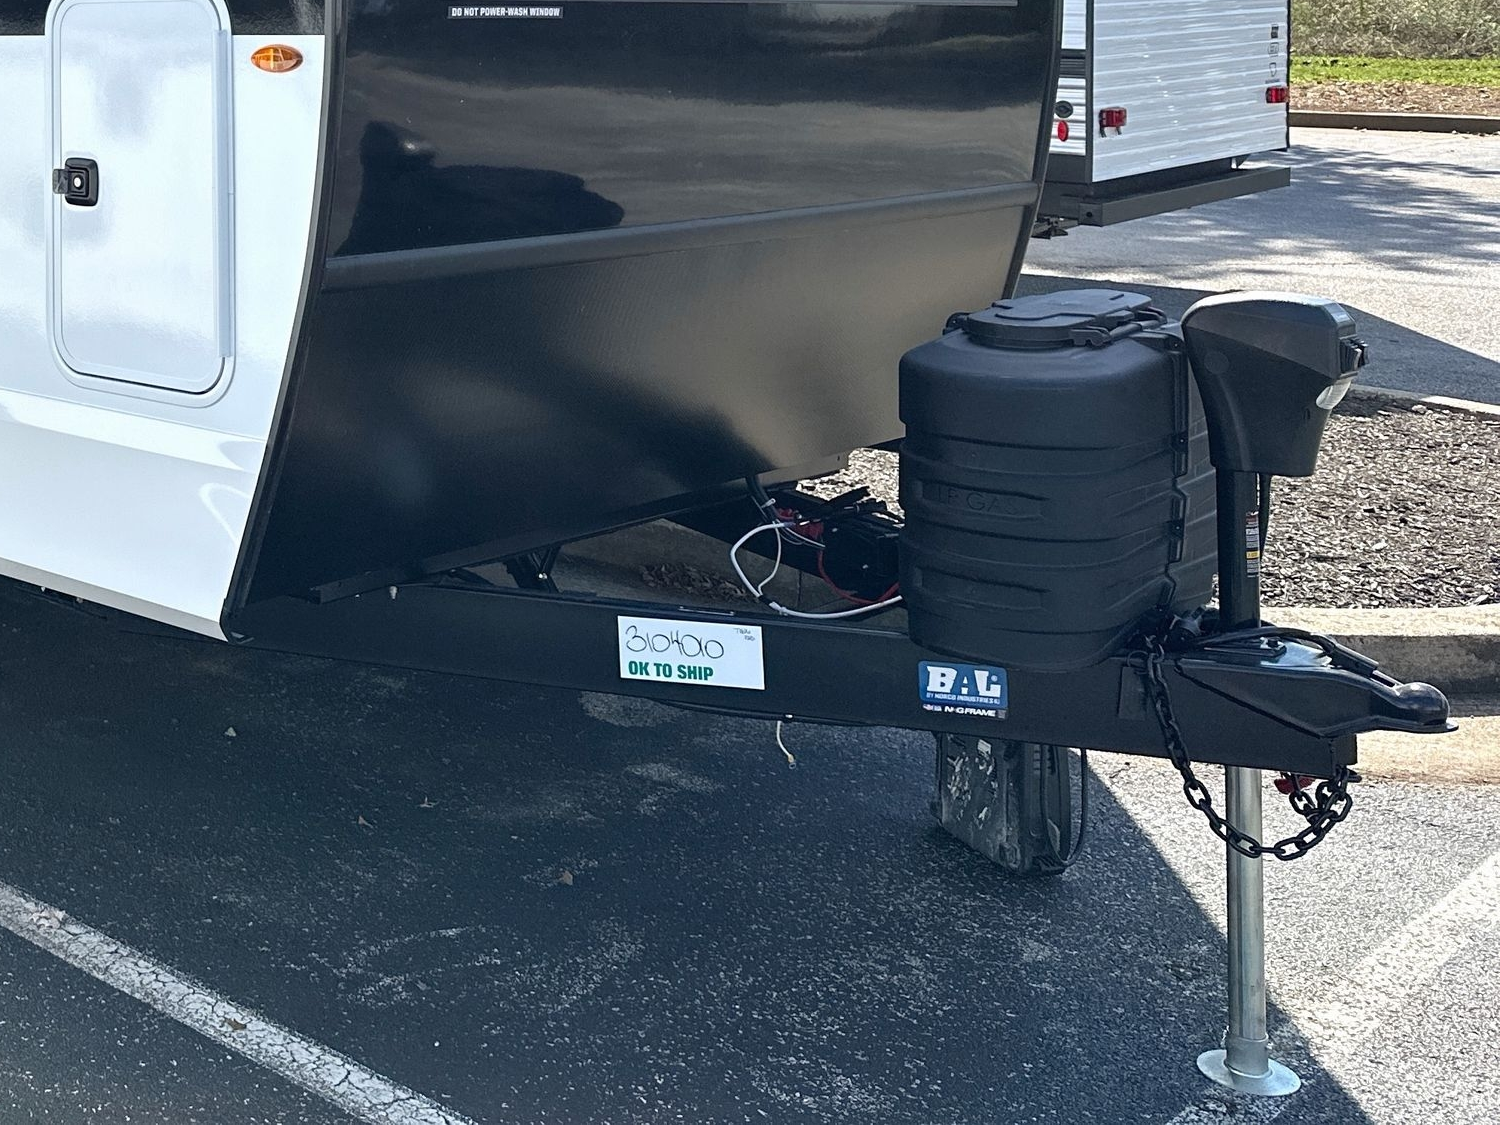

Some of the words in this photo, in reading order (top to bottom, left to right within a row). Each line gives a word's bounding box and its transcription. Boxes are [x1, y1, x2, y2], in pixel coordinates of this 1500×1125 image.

[452, 7, 462, 17] DO
[464, 7, 479, 17] NOT
[480, 7, 528, 16] POWER-WASH
[529, 7, 560, 16] WINDOW
[628, 660, 650, 676] OK
[653, 663, 672, 678] TO
[677, 664, 714, 681] SHIP
[926, 666, 1001, 698] BAL
